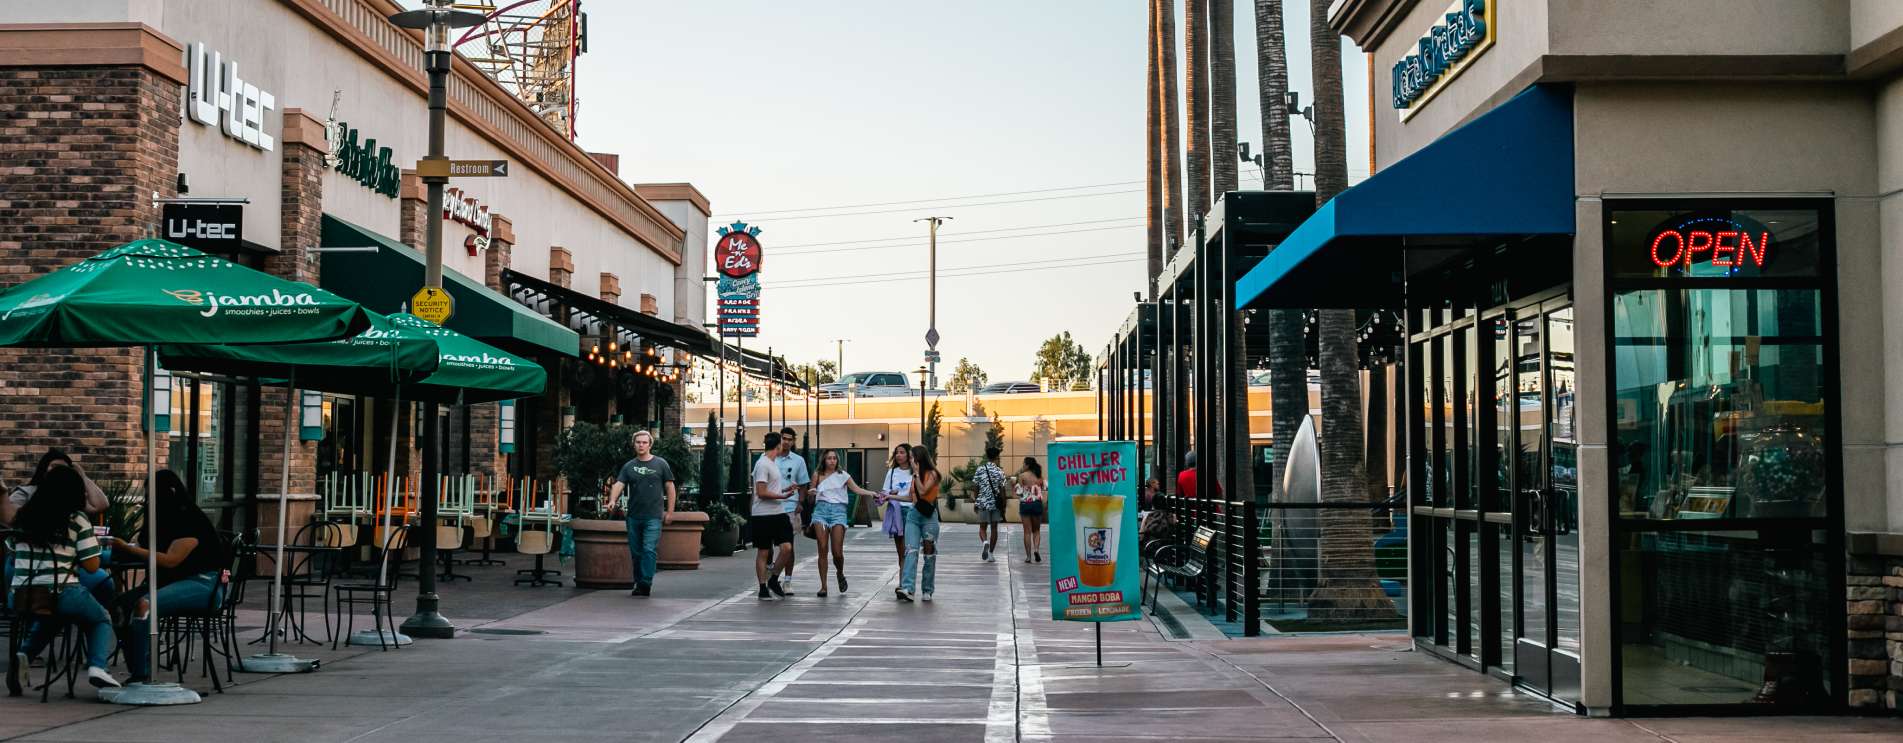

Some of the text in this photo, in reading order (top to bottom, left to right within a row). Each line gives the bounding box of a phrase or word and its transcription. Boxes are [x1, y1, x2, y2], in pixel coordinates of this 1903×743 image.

[194, 40, 275, 153] U-tec
[450, 163, 489, 174] Restroom
[169, 218, 236, 239] U-tec
[728, 238, 748, 251] Me
[1651, 230, 1769, 267] OPEN
[200, 288, 320, 318] jamba
[225, 307, 265, 316] smoothies
[269, 308, 292, 316] juices
[439, 352, 509, 365] amba
[1057, 451, 1120, 470] CHILLER
[1065, 467, 1127, 487] INSTINCT
[1058, 577, 1077, 591] NEW!
[1071, 592, 1121, 604] MANGO BOBA
